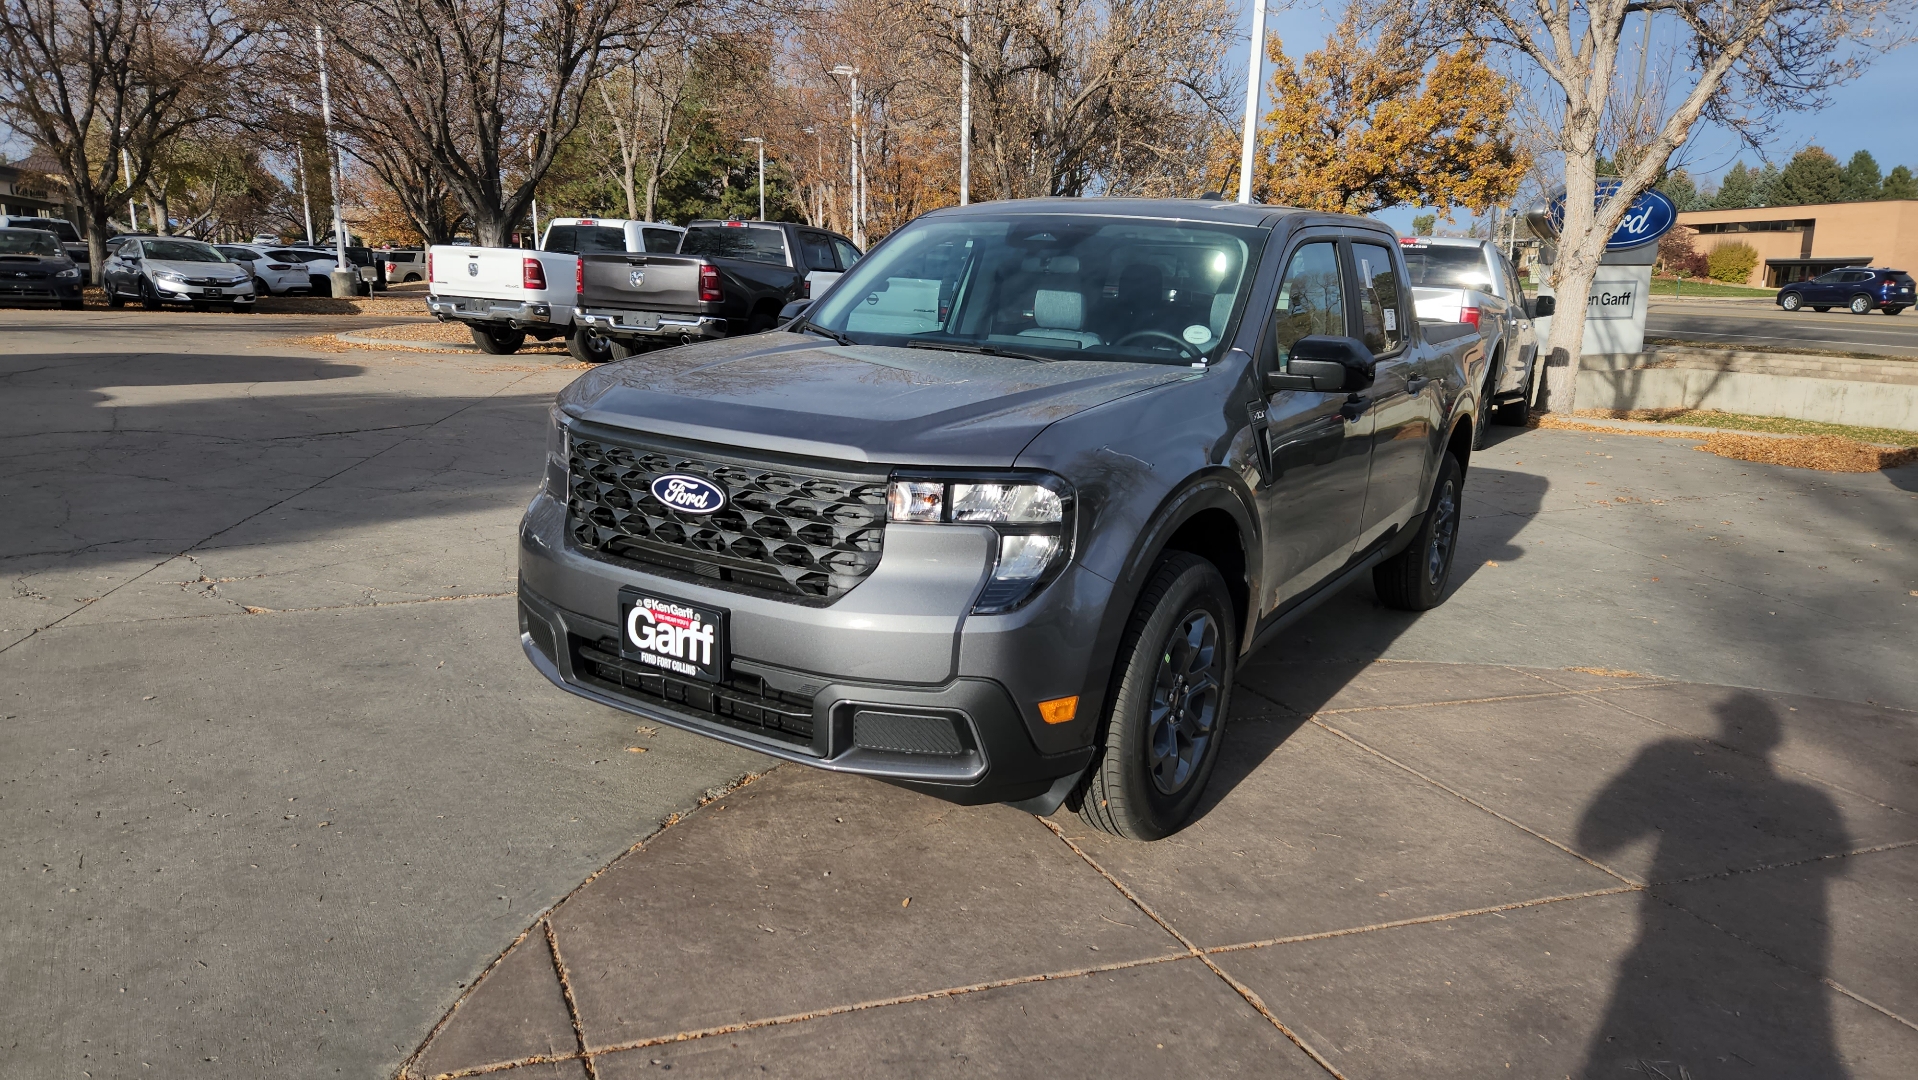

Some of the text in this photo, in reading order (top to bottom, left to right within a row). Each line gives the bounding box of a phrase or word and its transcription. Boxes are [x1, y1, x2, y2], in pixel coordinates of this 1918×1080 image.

[1601, 292, 1631, 306] Garff
[664, 479, 709, 508] Ford
[627, 606, 714, 665] Garff
[641, 652, 696, 676] FORD FORT COLLINS
